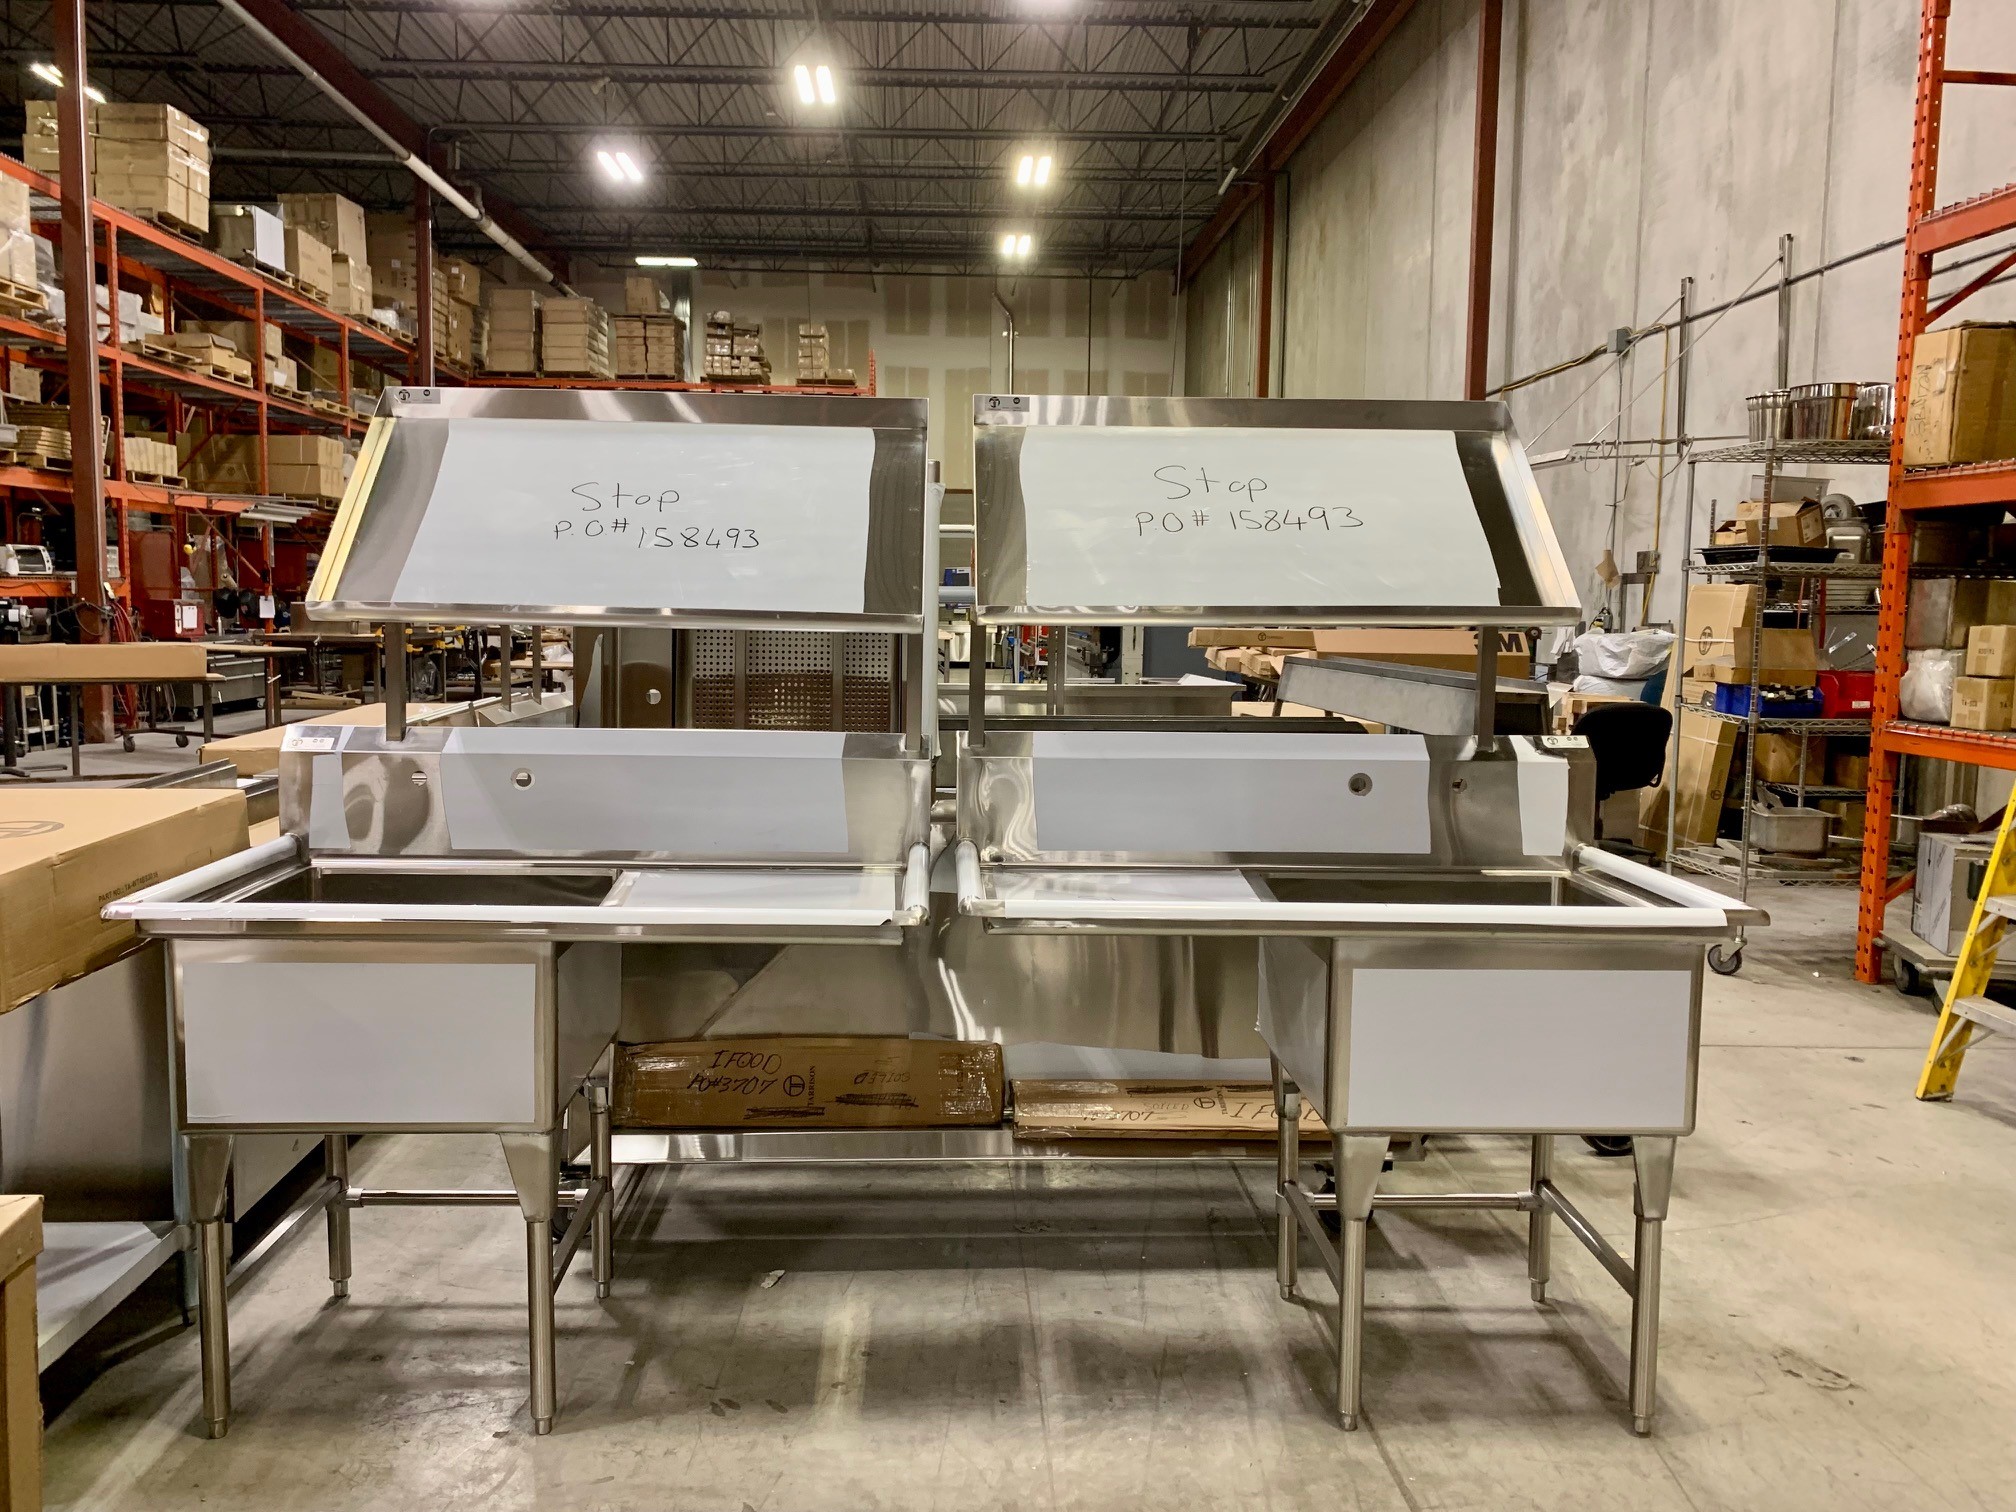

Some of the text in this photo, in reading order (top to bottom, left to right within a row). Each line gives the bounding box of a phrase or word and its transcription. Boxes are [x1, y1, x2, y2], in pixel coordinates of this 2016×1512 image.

[571, 481, 680, 512] Stop
[1153, 464, 1268, 502] Stop
[1229, 505, 1364, 531] 158493
[638, 526, 760, 549] 158493
[687, 1073, 778, 1095] PO#3707
[807, 1065, 817, 1107] TARRISON
